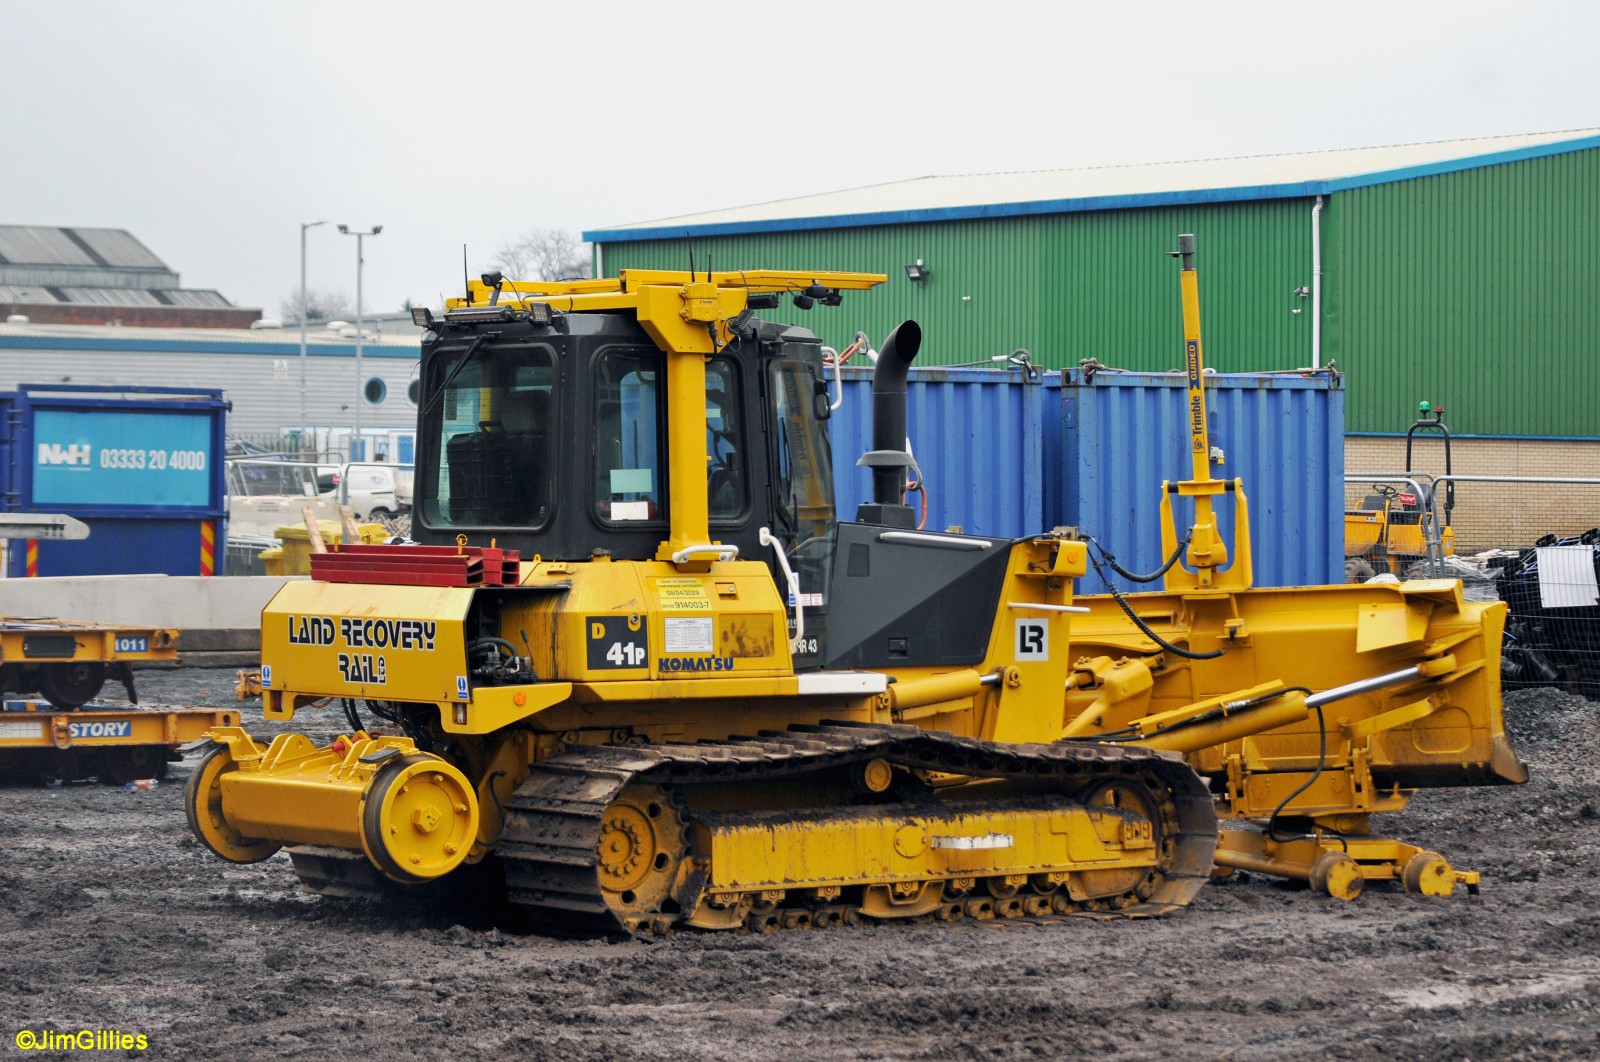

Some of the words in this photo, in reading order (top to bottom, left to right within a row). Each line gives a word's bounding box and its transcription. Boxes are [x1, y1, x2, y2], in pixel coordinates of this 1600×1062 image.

[1188, 344, 1197, 381] GUIDED
[1191, 395, 1202, 436] Trimble
[38, 443, 91, 465] NWH
[100, 449, 146, 468] 03333
[148, 450, 167, 470] 20
[168, 451, 205, 470] 4000
[675, 601, 709, 609] 914003-7
[288, 616, 336, 646] LAND
[341, 618, 436, 651] RECOVERY
[591, 622, 605, 639] D
[1020, 625, 1044, 653] LR
[114, 638, 145, 651] 1011
[606, 641, 645, 666] 41P
[808, 638, 818, 653] 43
[658, 655, 734, 671] KOMATSU
[69, 722, 128, 737] STORY
